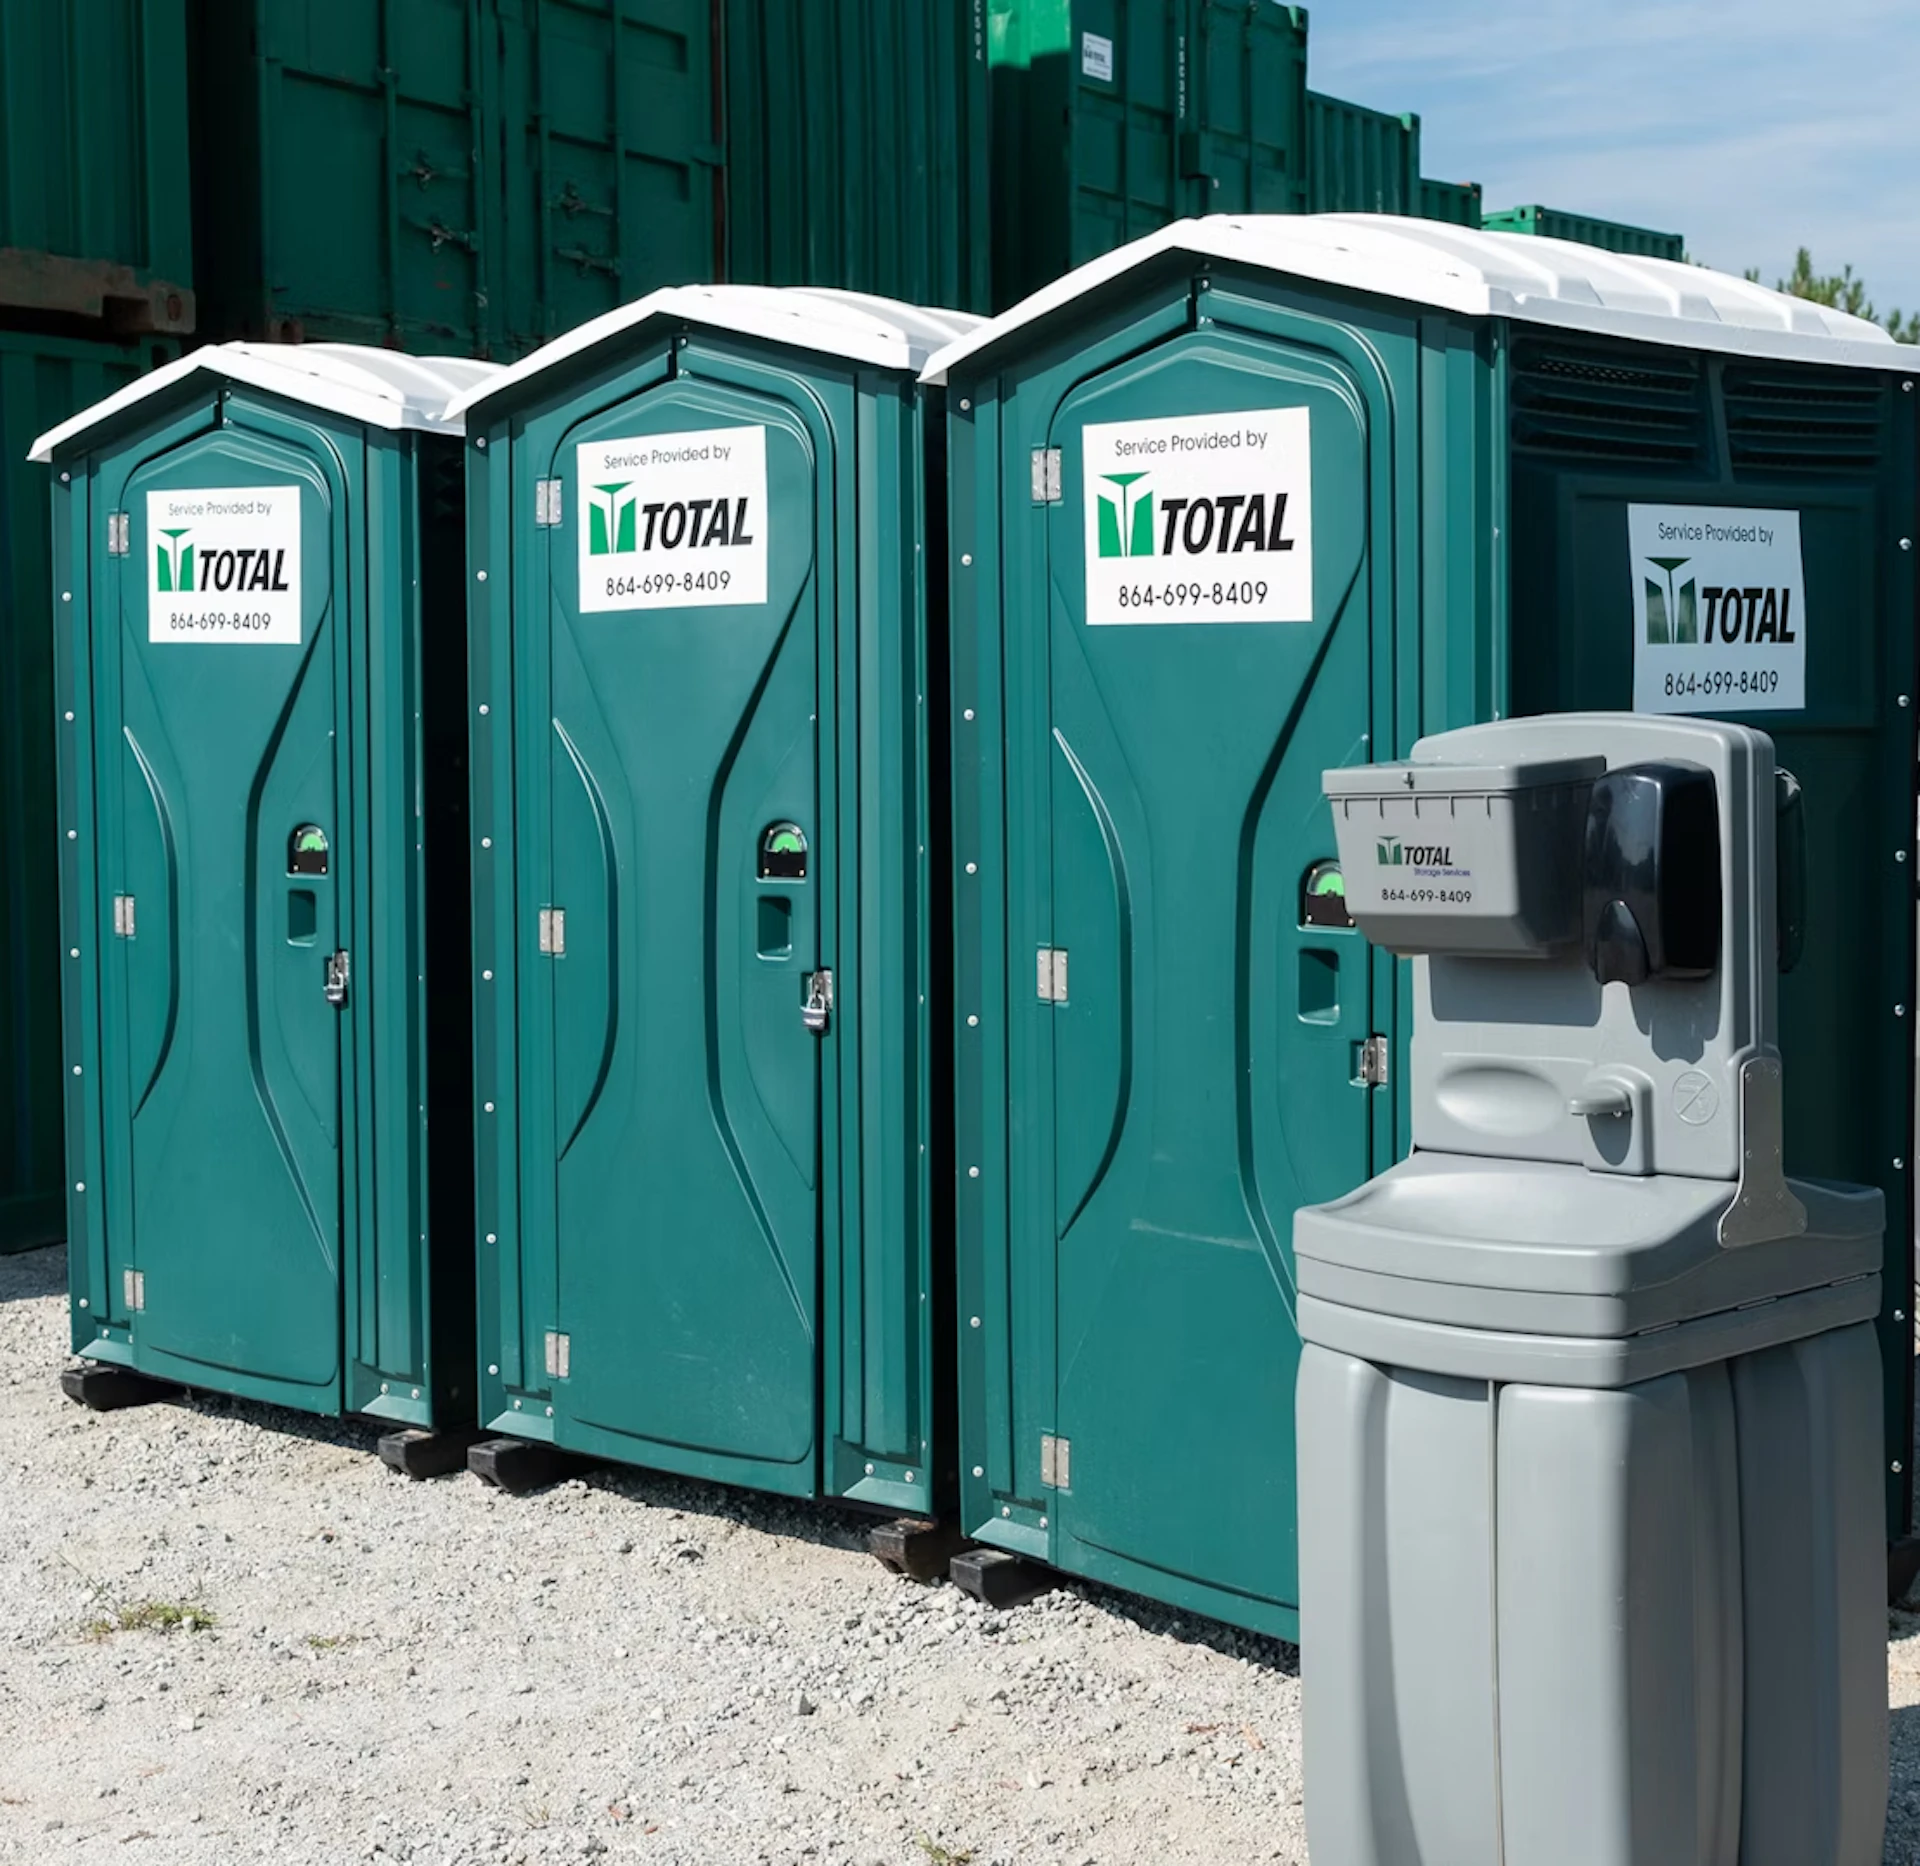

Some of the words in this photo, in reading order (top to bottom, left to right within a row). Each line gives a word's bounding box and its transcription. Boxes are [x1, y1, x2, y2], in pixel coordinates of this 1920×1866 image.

[604, 452, 648, 469] Service
[652, 446, 709, 464] Provided
[713, 444, 731, 461] by
[1115, 437, 1167, 457] Service
[1171, 430, 1241, 452] Provided
[1246, 430, 1268, 449] by
[168, 503, 204, 516] Service
[206, 501, 253, 515] Provided
[257, 501, 273, 516] by
[642, 497, 754, 552] TOTAL
[1160, 493, 1295, 556] TOTAL
[1658, 522, 1702, 541] Service
[1705, 524, 1756, 542] Provided
[1759, 526, 1774, 546] by
[199, 549, 289, 592] TOTAL
[606, 570, 731, 597] 864-699-8409
[1118, 581, 1268, 608] 864-699-8409
[170, 612, 271, 630] 864-699-8409
[1702, 587, 1796, 644] TOTAL
[1664, 670, 1779, 696] 864-699-8409
[1404, 846, 1453, 866] TOTAL
[1414, 867, 1441, 877] Storage
[1442, 867, 1471, 877] Services
[1381, 888, 1472, 903] 864-699-8409
